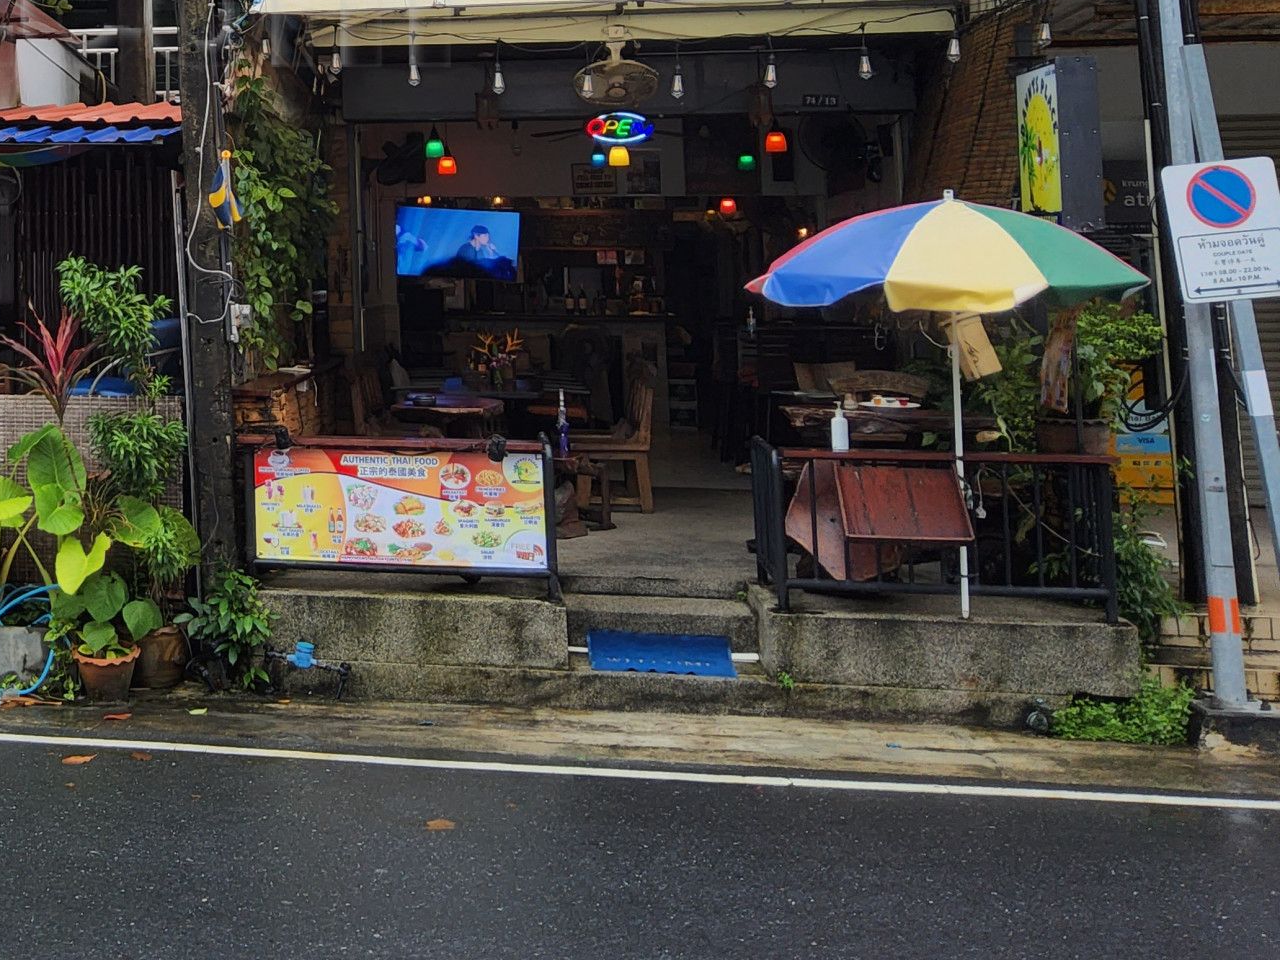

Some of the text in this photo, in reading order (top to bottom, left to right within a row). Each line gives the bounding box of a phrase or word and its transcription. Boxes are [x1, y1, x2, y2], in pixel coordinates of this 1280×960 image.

[586, 117, 655, 137] OPEN
[1197, 233, 1266, 250] ห้ามจอดวันคู่
[342, 455, 438, 466] AUTHENTIC THAI FOOD
[359, 466, 427, 478] 正宗的泰國美食
